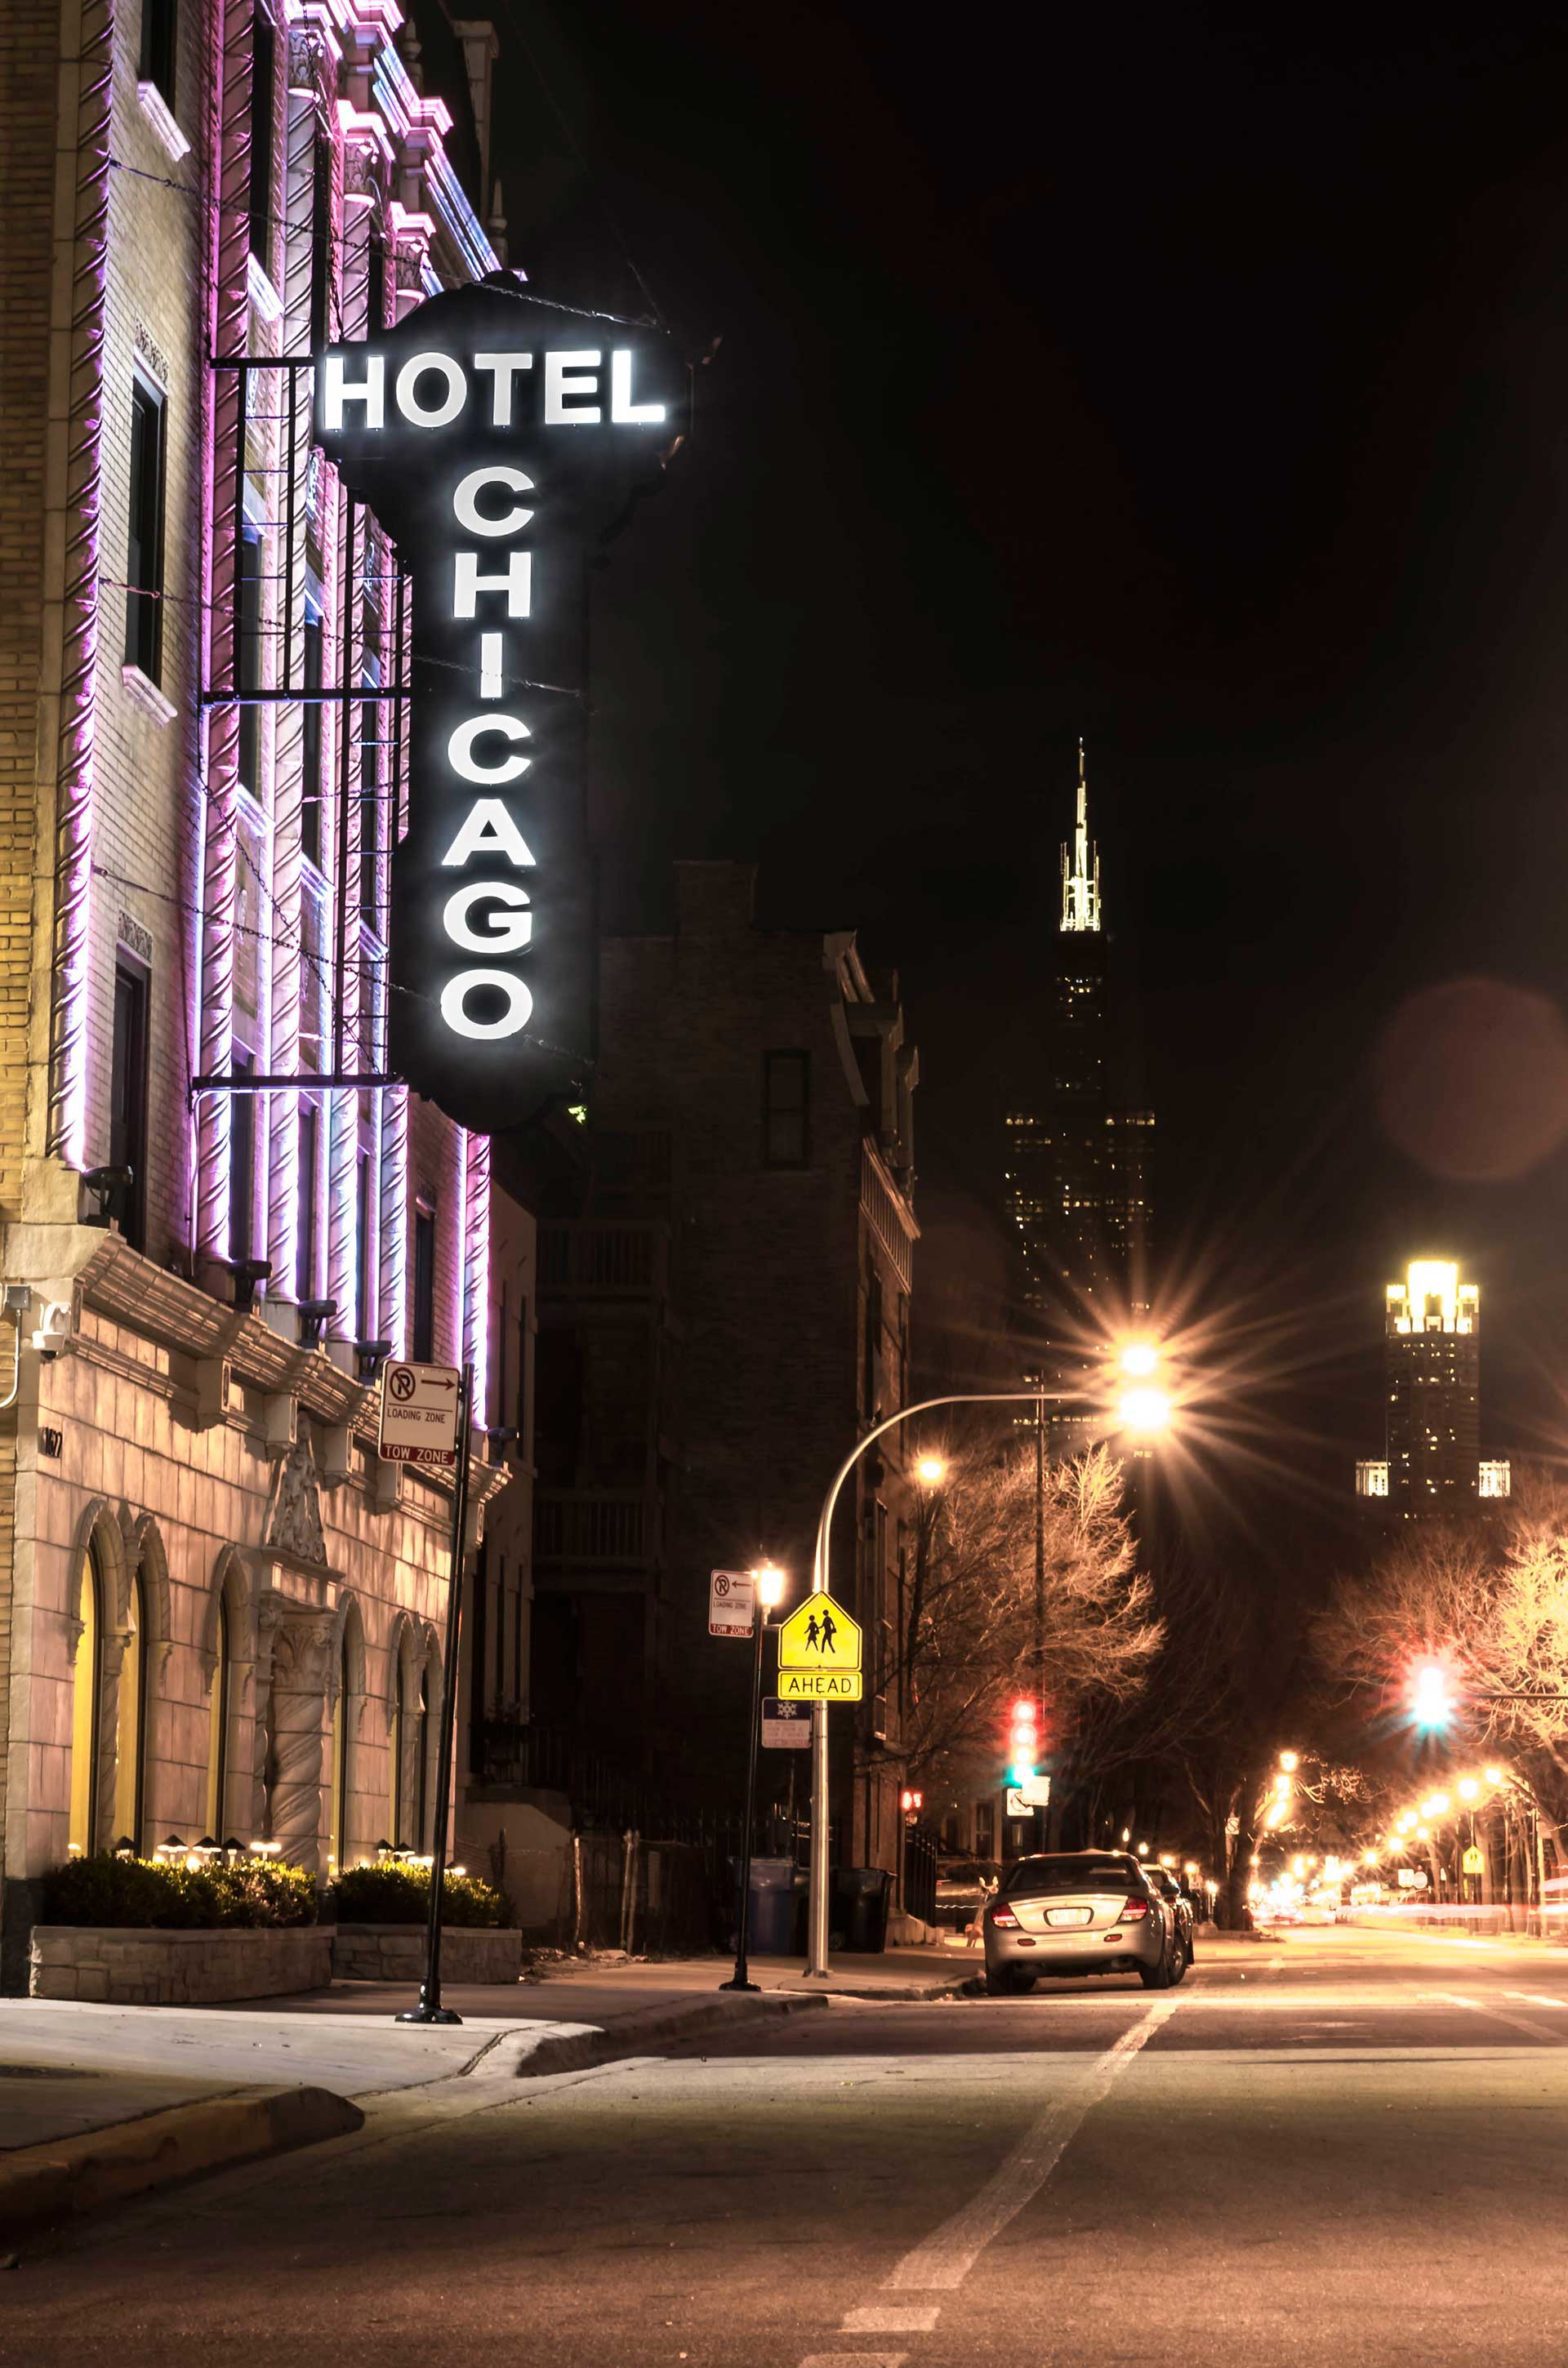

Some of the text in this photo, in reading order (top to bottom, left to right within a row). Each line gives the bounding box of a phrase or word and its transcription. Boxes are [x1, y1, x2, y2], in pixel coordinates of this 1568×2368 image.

[325, 350, 666, 430] HOTEL
[440, 466, 537, 1040] CHICAGO
[387, 1408, 446, 1424] LOADING ZONE
[385, 1445, 449, 1464] TOW ZONE
[712, 1625, 749, 1636] TOW ZONE
[788, 1677, 852, 1694] AHEAD
